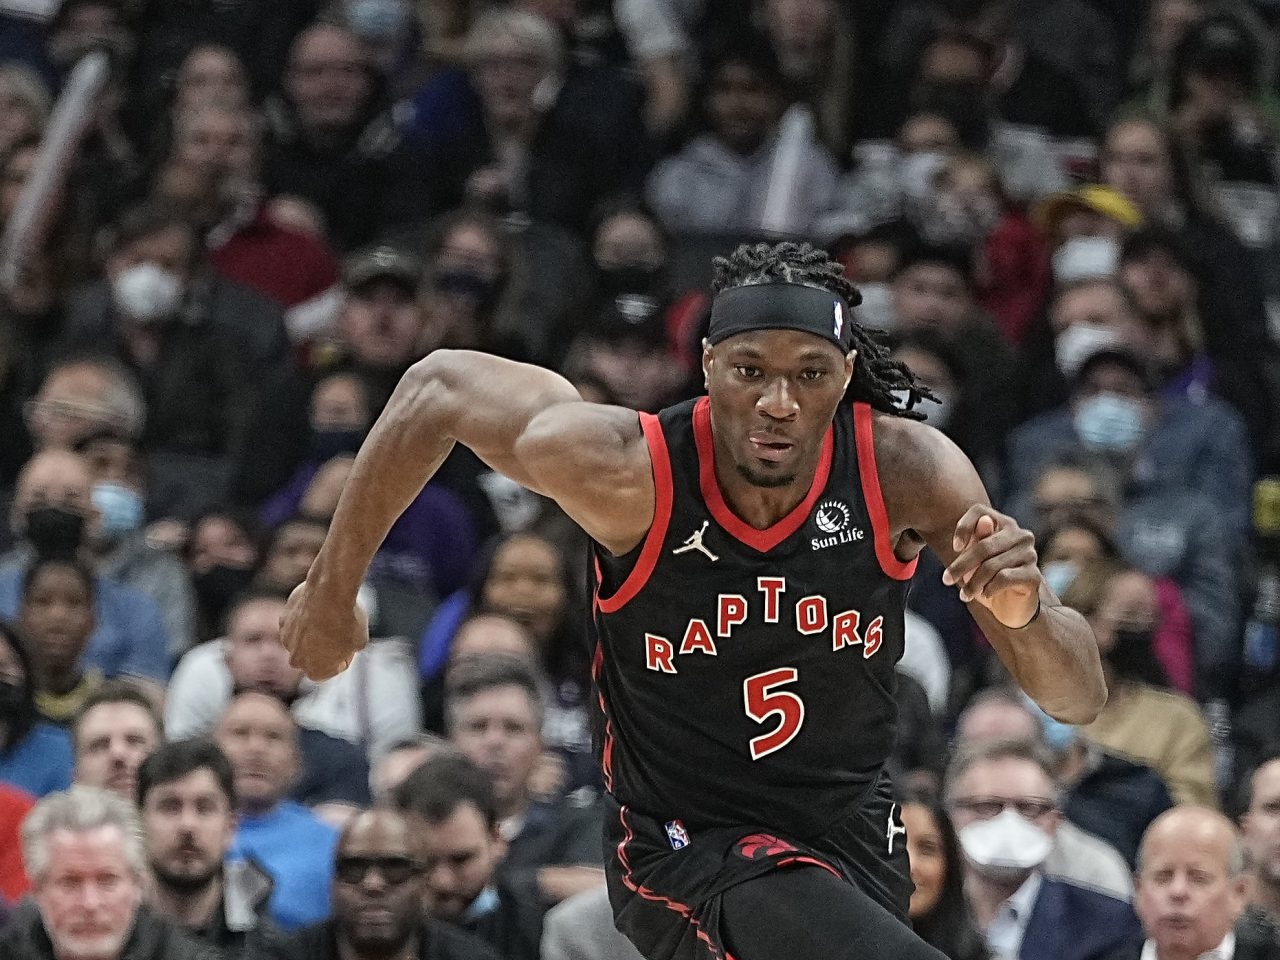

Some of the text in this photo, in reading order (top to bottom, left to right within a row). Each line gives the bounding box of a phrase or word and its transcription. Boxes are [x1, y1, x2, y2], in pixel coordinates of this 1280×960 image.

[811, 527, 864, 551] Sun Life
[645, 576, 883, 674] RAPTORS
[744, 667, 805, 761] 5
